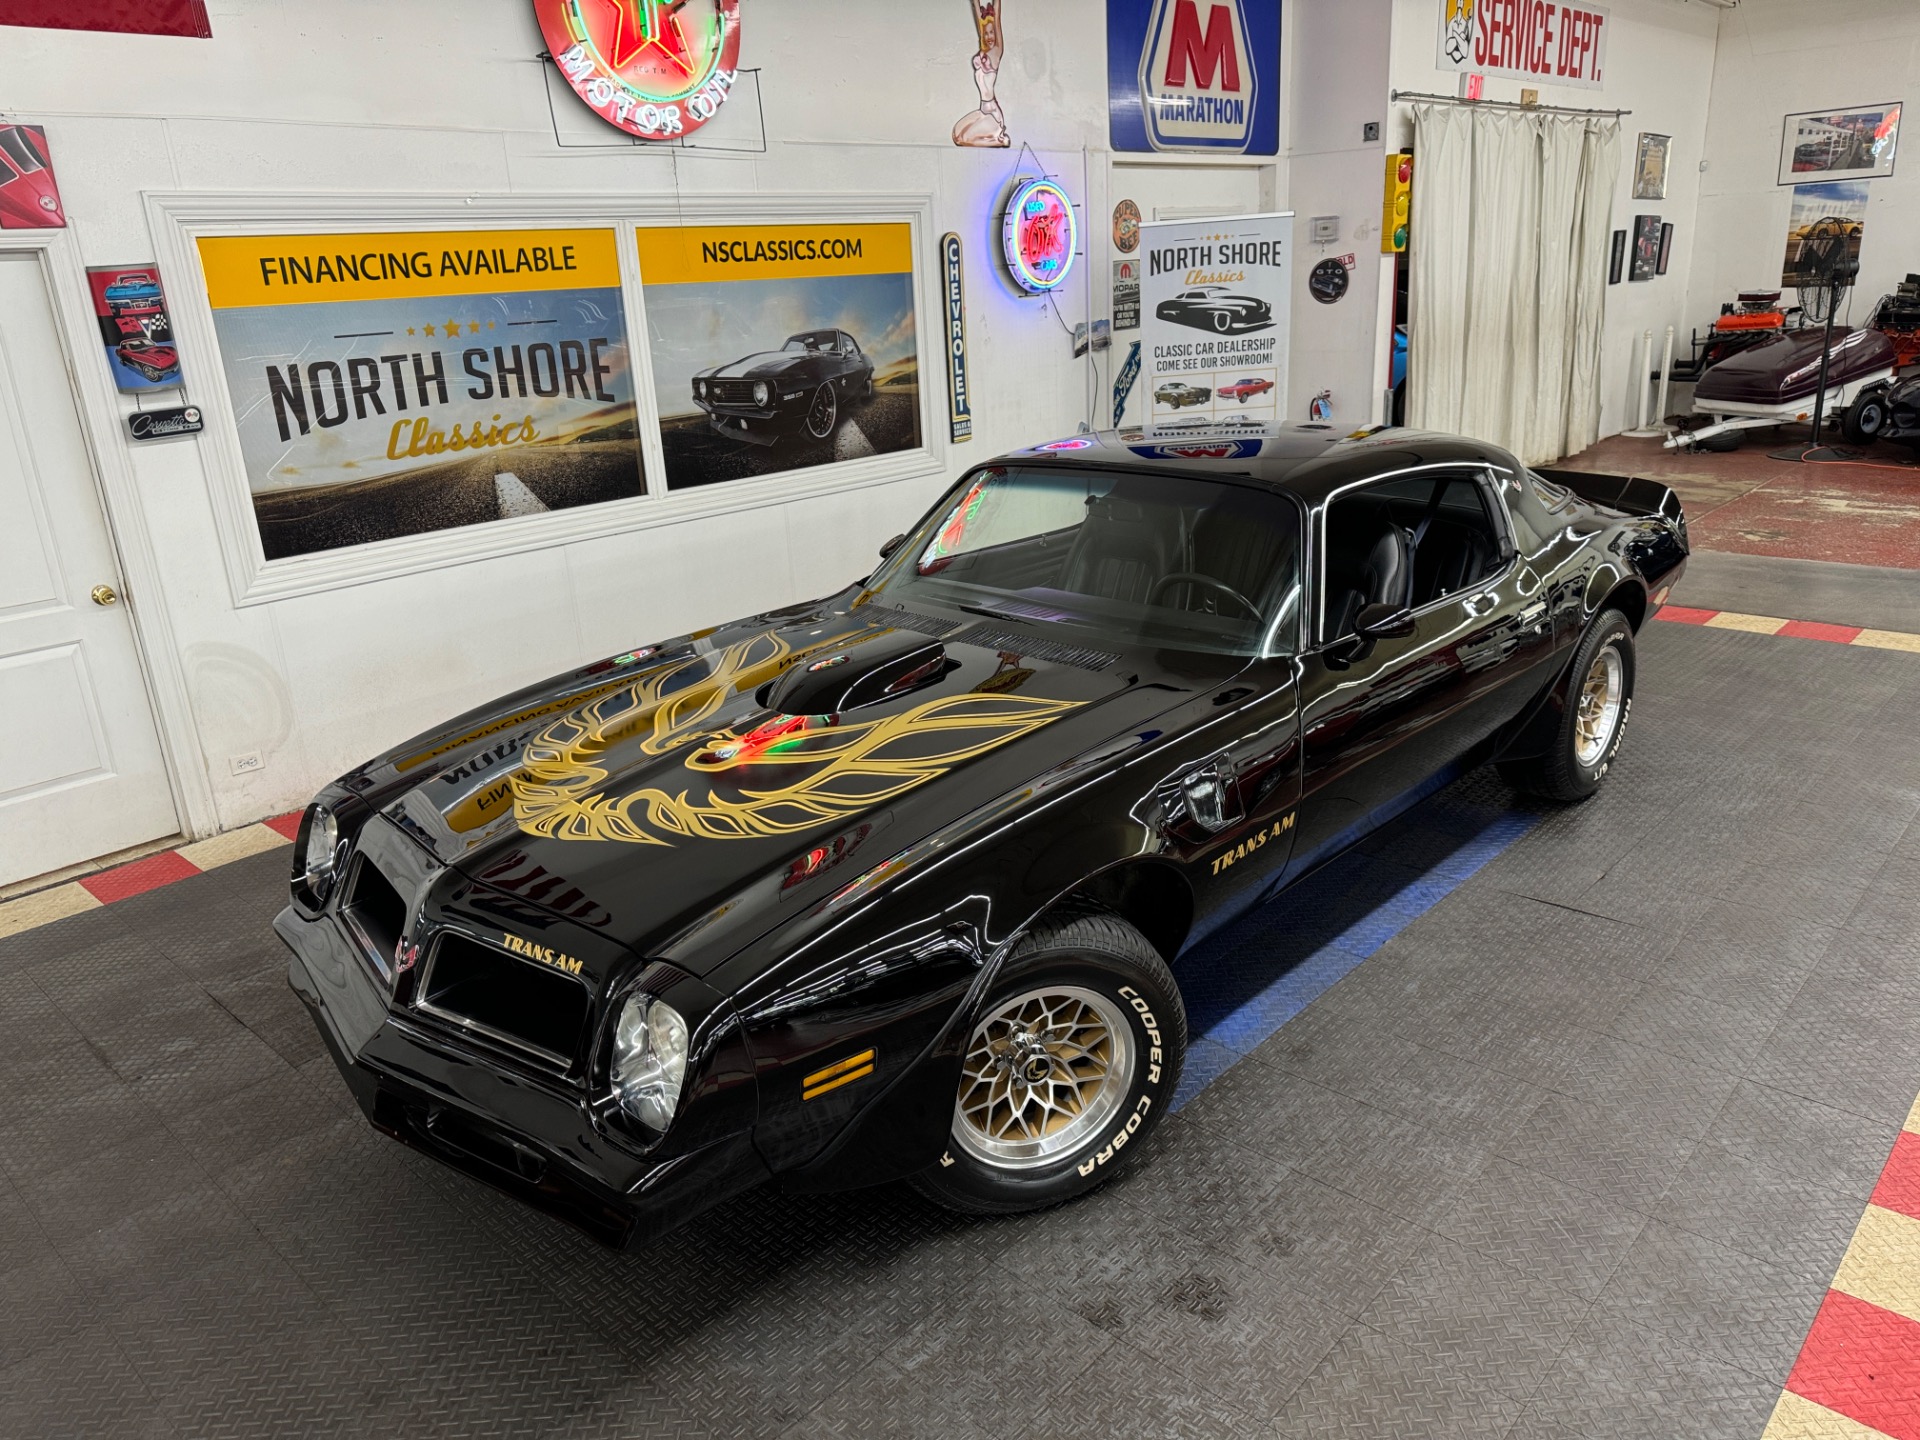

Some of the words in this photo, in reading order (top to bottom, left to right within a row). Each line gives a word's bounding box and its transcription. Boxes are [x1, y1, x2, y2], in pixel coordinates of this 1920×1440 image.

[1475, 0, 1555, 74] SERVICE
[1557, 7, 1603, 82] DEPT.
[557, 43, 683, 135] MOTOR
[685, 69, 738, 122] OIL
[1468, 74, 1485, 100] EXIT
[1159, 93, 1244, 125] MARATHON
[260, 251, 432, 286] FINANCING
[440, 245, 577, 277] AVAILABLE
[702, 238, 862, 263] NSCLASSICS.COM
[1150, 246, 1212, 276] NORTH
[1219, 240, 1281, 267] SHORE
[1184, 269, 1246, 285] Classics
[949, 243, 964, 412] CHEVROLET
[1154, 343, 1192, 358] CLASSIC
[1195, 342, 1214, 355] CAR
[1217, 338, 1276, 354] DEALERSHIP
[1119, 359, 1138, 397] Ford
[1157, 360, 1180, 371] COME
[1183, 358, 1198, 370] SEE
[1201, 357, 1218, 368] OUR
[1220, 353, 1273, 368] SHOWROOM!
[266, 351, 449, 443] NORTH
[463, 337, 616, 403] SHORE
[132, 414, 188, 436] Corvette
[386, 414, 541, 461] Classics
[1610, 697, 1632, 760] RADIAL
[1211, 829, 1268, 876] TRANS
[1269, 811, 1296, 840] AM
[503, 932, 554, 965] TRANS
[554, 953, 583, 975] AM
[1117, 985, 1163, 1084] COOPER
[1077, 1094, 1151, 1178] COBRA
